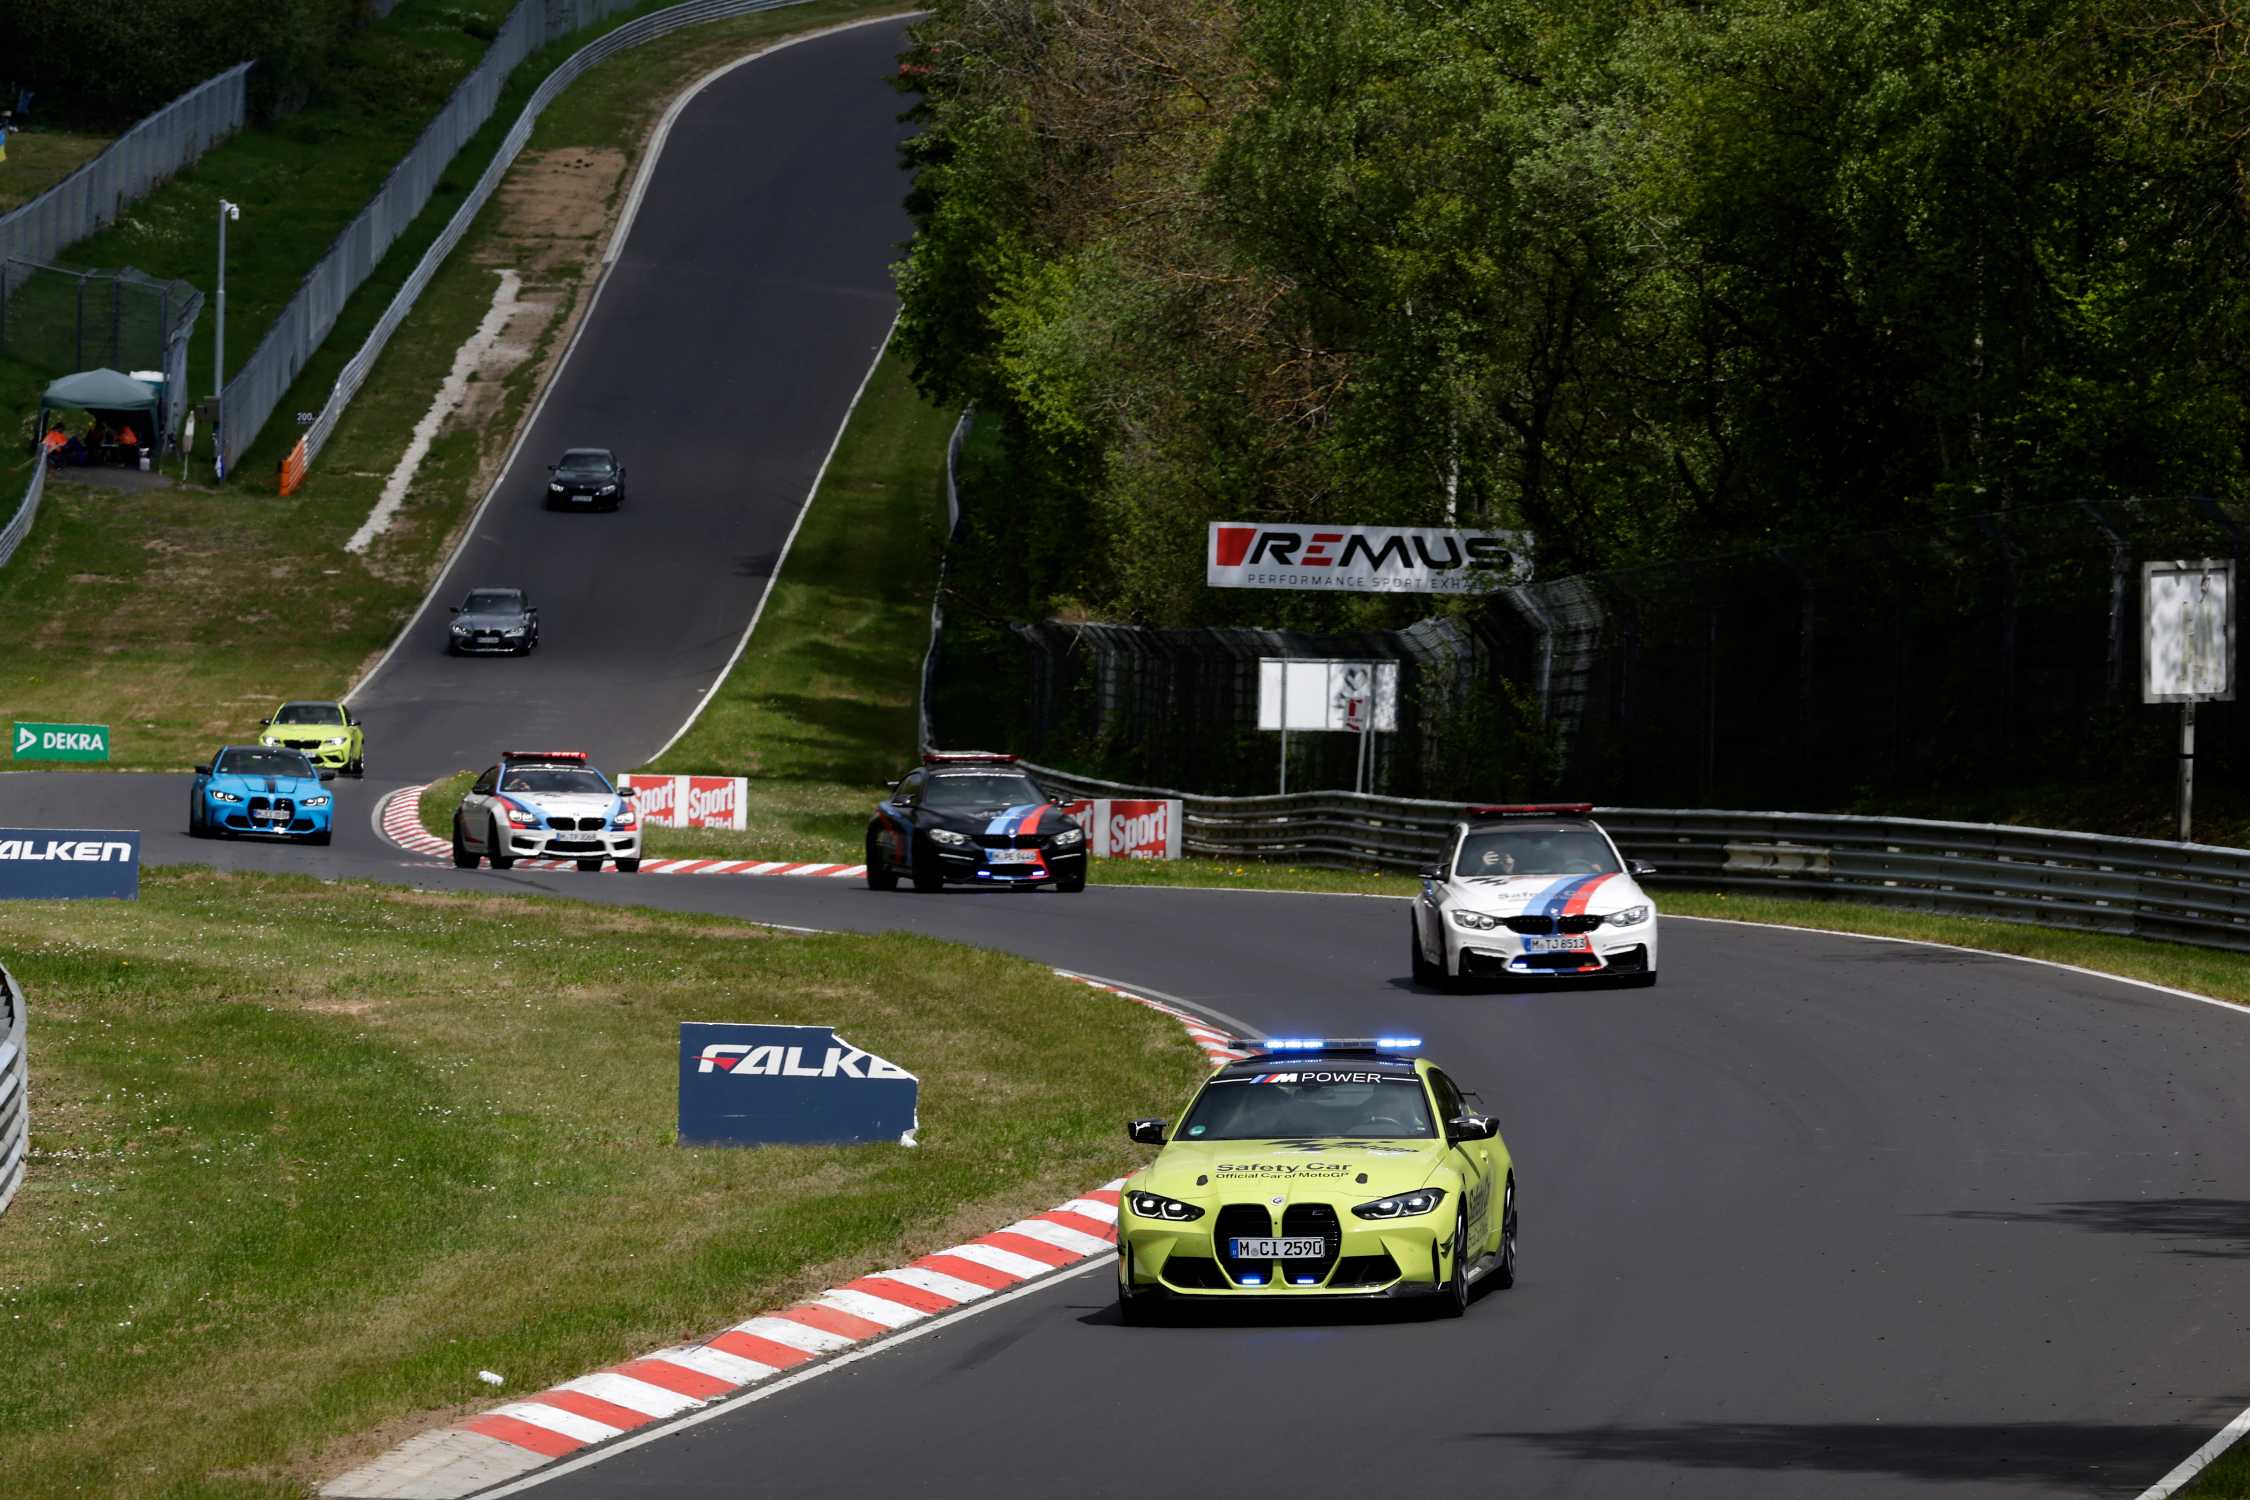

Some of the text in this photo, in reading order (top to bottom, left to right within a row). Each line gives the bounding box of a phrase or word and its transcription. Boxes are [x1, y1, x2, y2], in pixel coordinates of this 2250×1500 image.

[1249, 532, 1513, 572] REMUS
[1248, 574, 1484, 590] PERFORMANCE SPORT EXHA
[43, 732, 104, 751] DEKRA
[690, 781, 734, 819] Sport
[1111, 805, 1166, 855] Sport
[0, 840, 132, 862] ALKEN
[1546, 939, 1558, 949] TJ
[1561, 938, 1585, 949] 8513
[1301, 1072, 1381, 1083] POWER
[1217, 1162, 1352, 1173] Safety Car
[1240, 1241, 1321, 1256] M CI 2590
